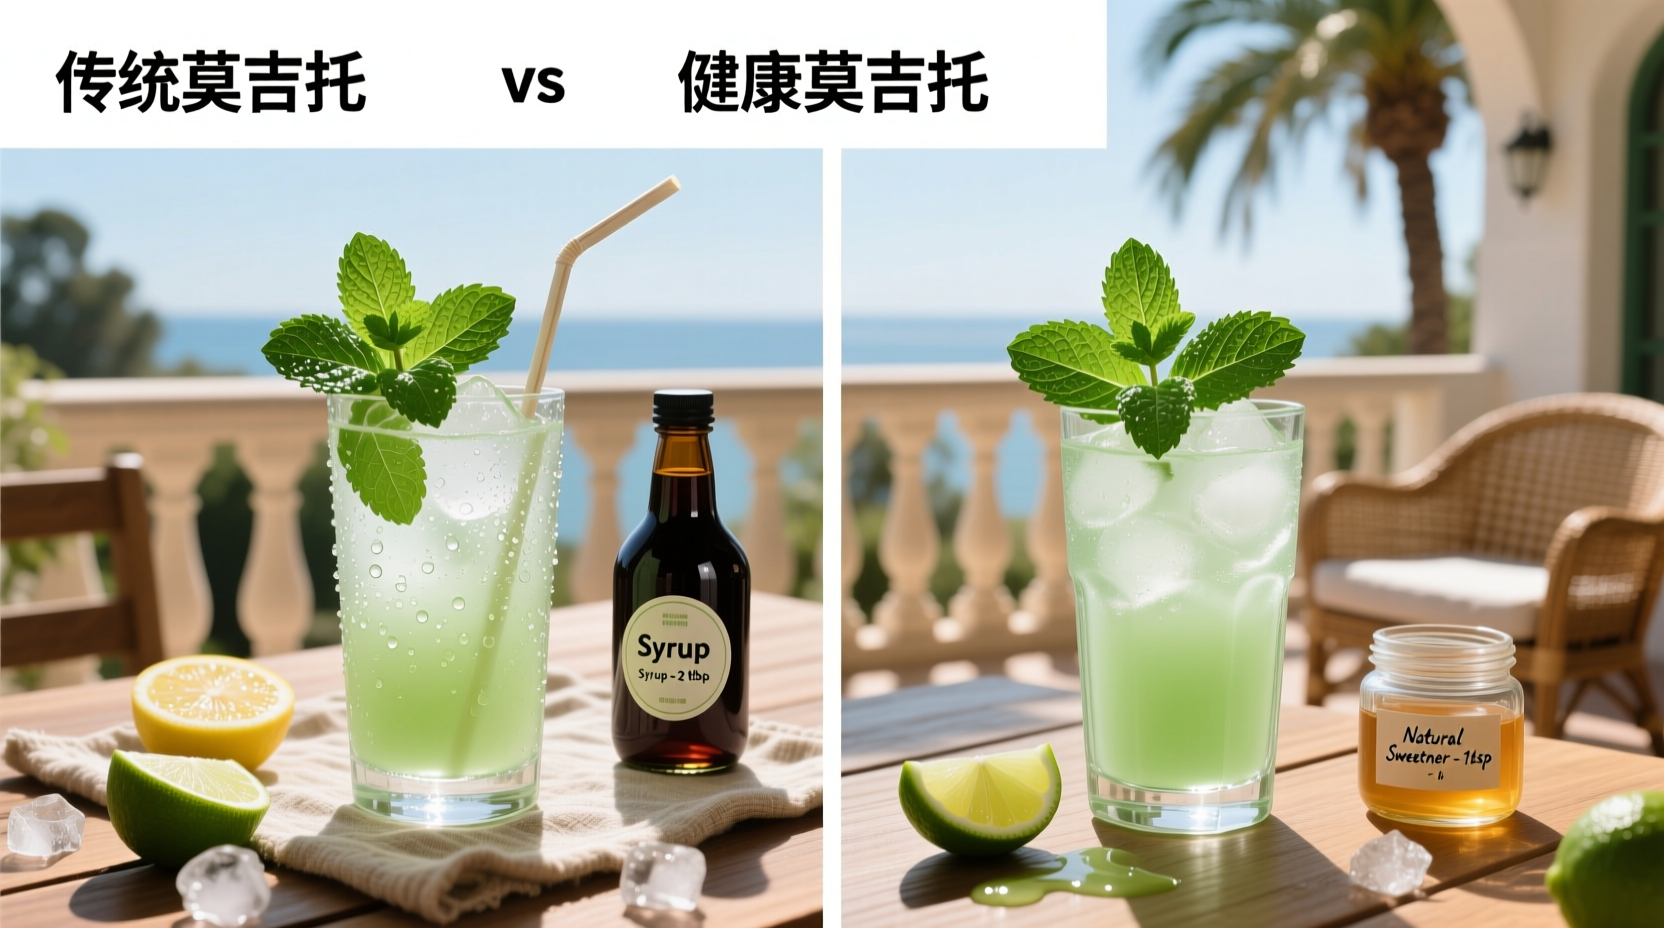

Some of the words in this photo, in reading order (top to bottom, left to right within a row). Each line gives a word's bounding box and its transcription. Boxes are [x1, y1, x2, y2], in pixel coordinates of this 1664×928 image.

[637, 634, 710, 664] Syrup
[638, 668, 668, 683] Syrup
[1403, 725, 1464, 745] Natural
